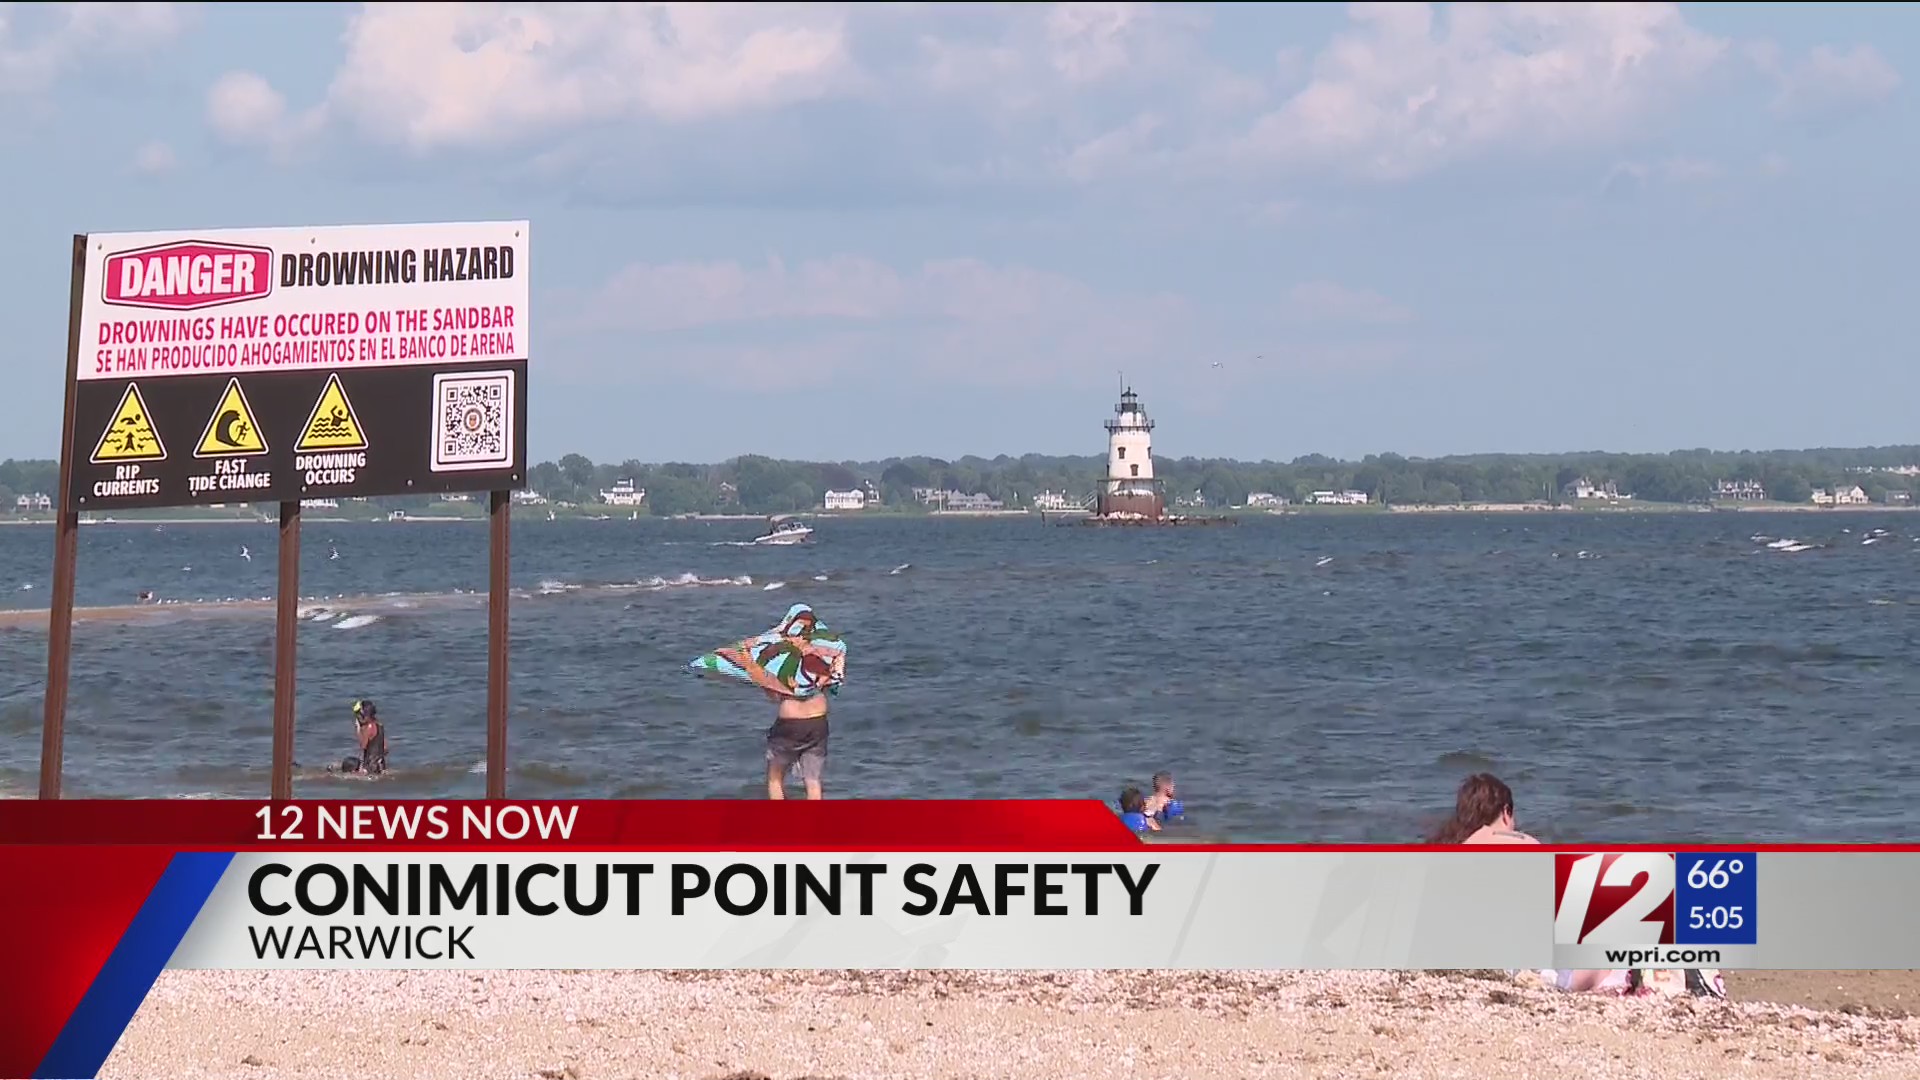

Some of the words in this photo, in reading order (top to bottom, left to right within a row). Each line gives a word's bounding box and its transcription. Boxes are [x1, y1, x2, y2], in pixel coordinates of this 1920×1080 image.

[120, 253, 256, 298] DANGER
[280, 249, 416, 288] DROWNING
[423, 245, 514, 282] HAZARD
[99, 317, 215, 345] DROWNINGS
[221, 315, 269, 339] HAVE
[274, 311, 359, 337] OCCURED
[364, 311, 390, 334] ON
[394, 310, 428, 332] THE
[433, 305, 514, 330] SANDBAR
[96, 349, 112, 373] SE
[116, 347, 147, 371] HAN
[152, 342, 237, 370] PRODUCIDO
[241, 338, 355, 366] AHOGAMIENTOS
[359, 338, 377, 360] EN
[382, 338, 396, 359] EL
[399, 335, 446, 358] BANCO
[451, 334, 466, 356] DE
[470, 332, 514, 356] ARENA
[214, 459, 247, 475] FAST
[296, 453, 367, 471] DROWNING
[115, 465, 140, 481] RIP
[189, 475, 217, 492] TIDE
[219, 472, 271, 490] CHANGE
[305, 469, 356, 486] OCCURS
[93, 479, 160, 497] CURRENTS
